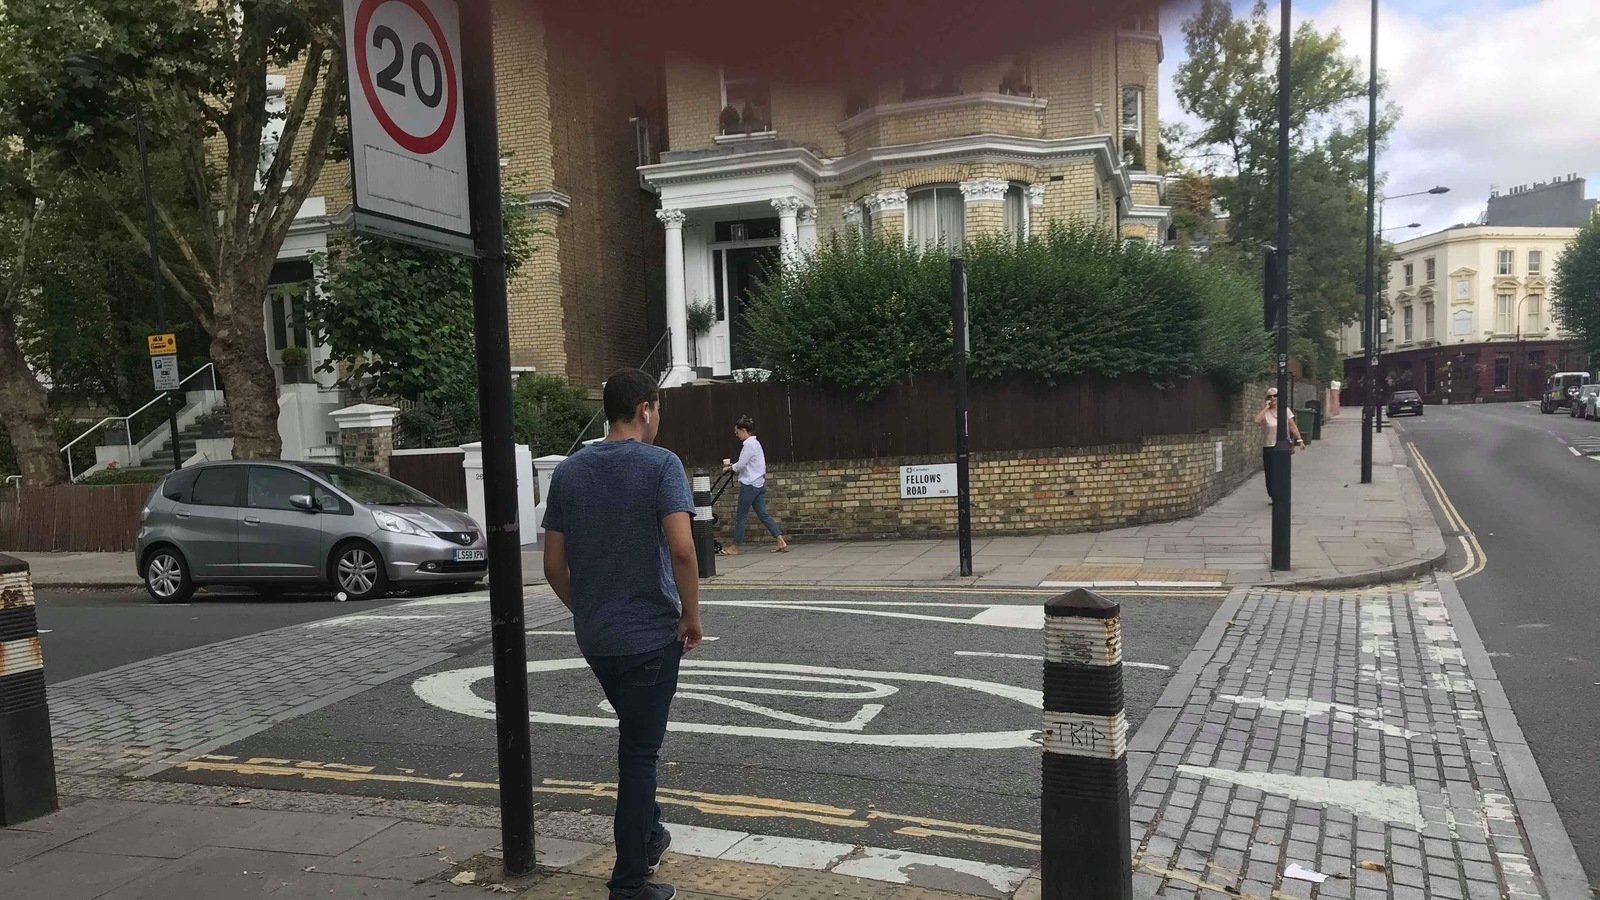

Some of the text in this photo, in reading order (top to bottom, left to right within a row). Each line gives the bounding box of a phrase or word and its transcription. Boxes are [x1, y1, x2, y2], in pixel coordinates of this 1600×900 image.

[373, 24, 443, 108] 20
[906, 473, 942, 484] FELLOWS
[906, 486, 927, 496] ROAD
[1051, 720, 1106, 750] TRIP
